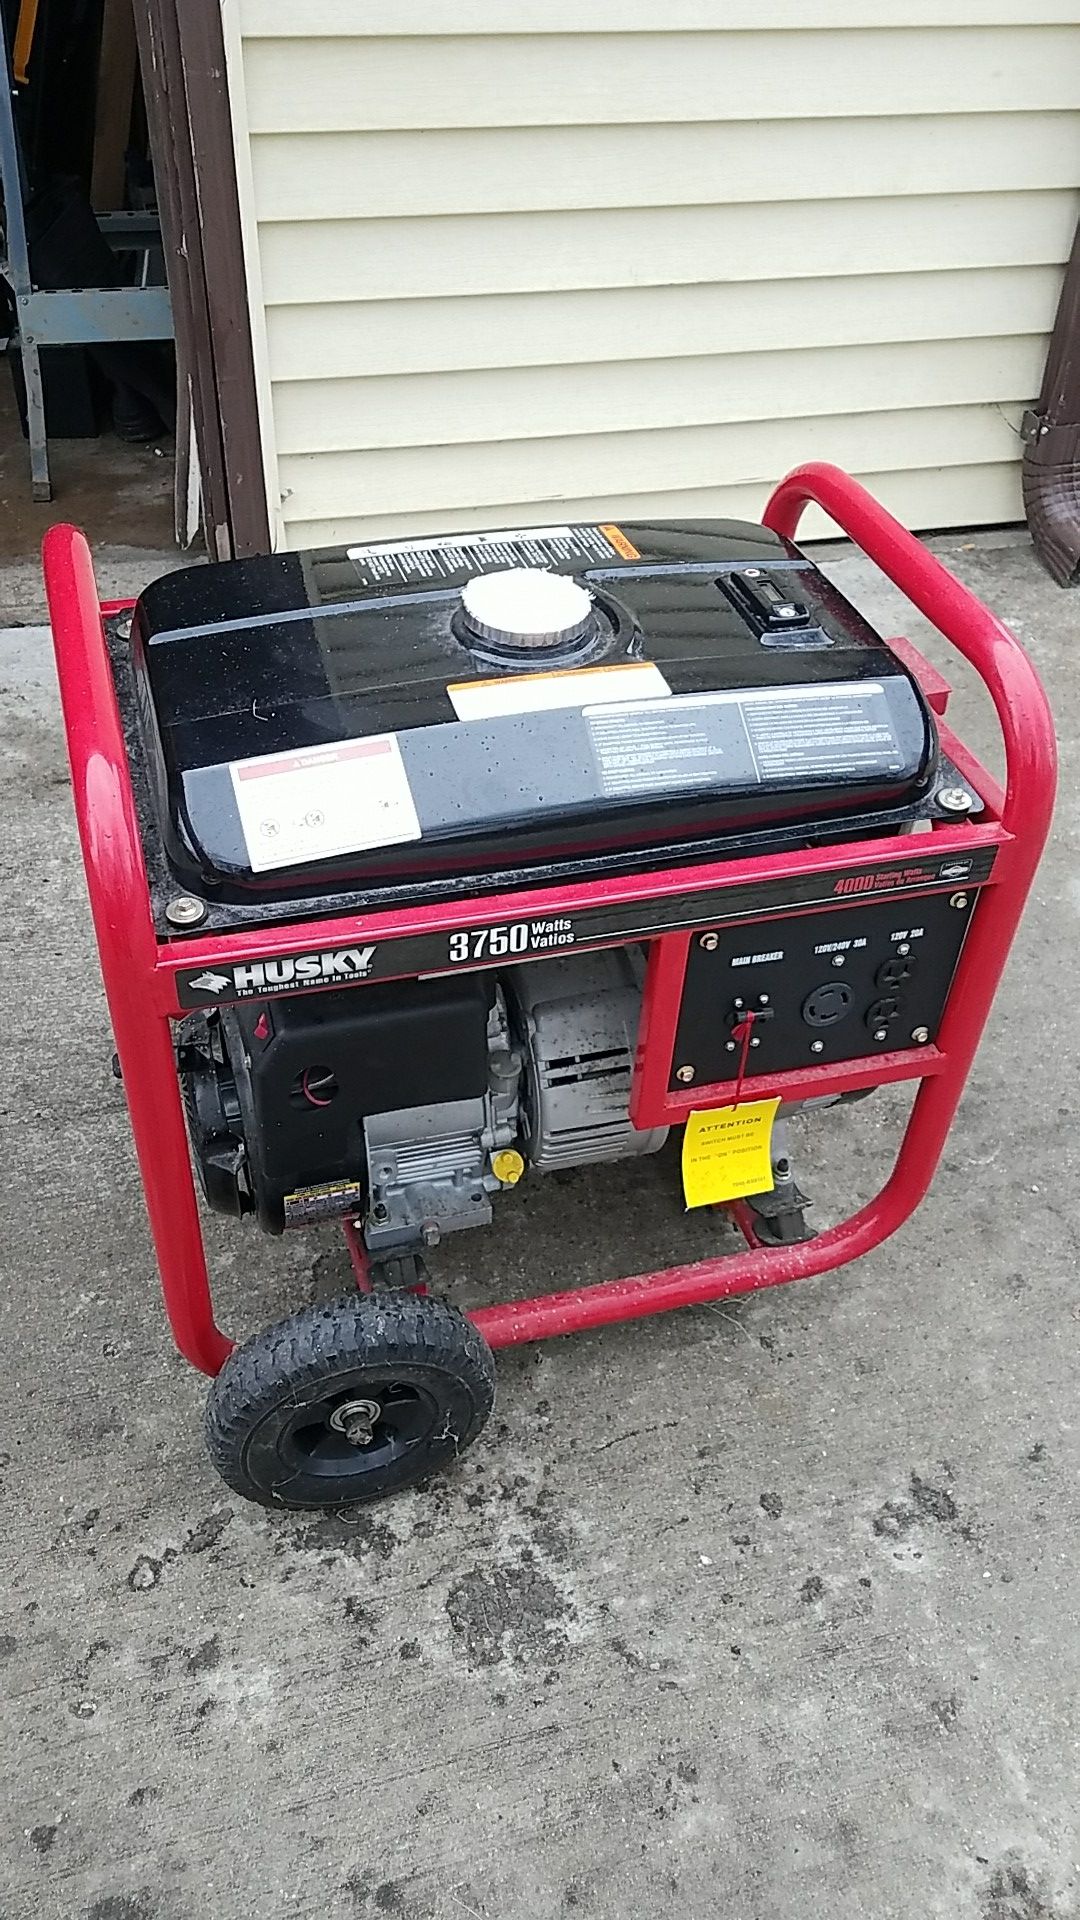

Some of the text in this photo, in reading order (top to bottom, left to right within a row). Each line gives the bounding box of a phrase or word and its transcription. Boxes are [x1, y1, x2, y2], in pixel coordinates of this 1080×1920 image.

[834, 875, 875, 895] 4000
[532, 919, 572, 935] Watts
[890, 928, 925, 941] 120V 20A
[450, 924, 528, 961] 3750
[531, 933, 575, 949] Vatios
[814, 938, 867, 954] 120V/240V 30A
[731, 951, 784, 967] MAIN BREAKER
[233, 946, 377, 990] HUSKY
[236, 989, 254, 997] The
[258, 981, 300, 993] Toughest
[303, 976, 330, 987] Name
[332, 974, 342, 982] In
[699, 1117, 761, 1133] ATTENTION
[727, 1133, 744, 1142] MUST
[690, 1156, 698, 1164] IN
[732, 1145, 762, 1154] POSITION
